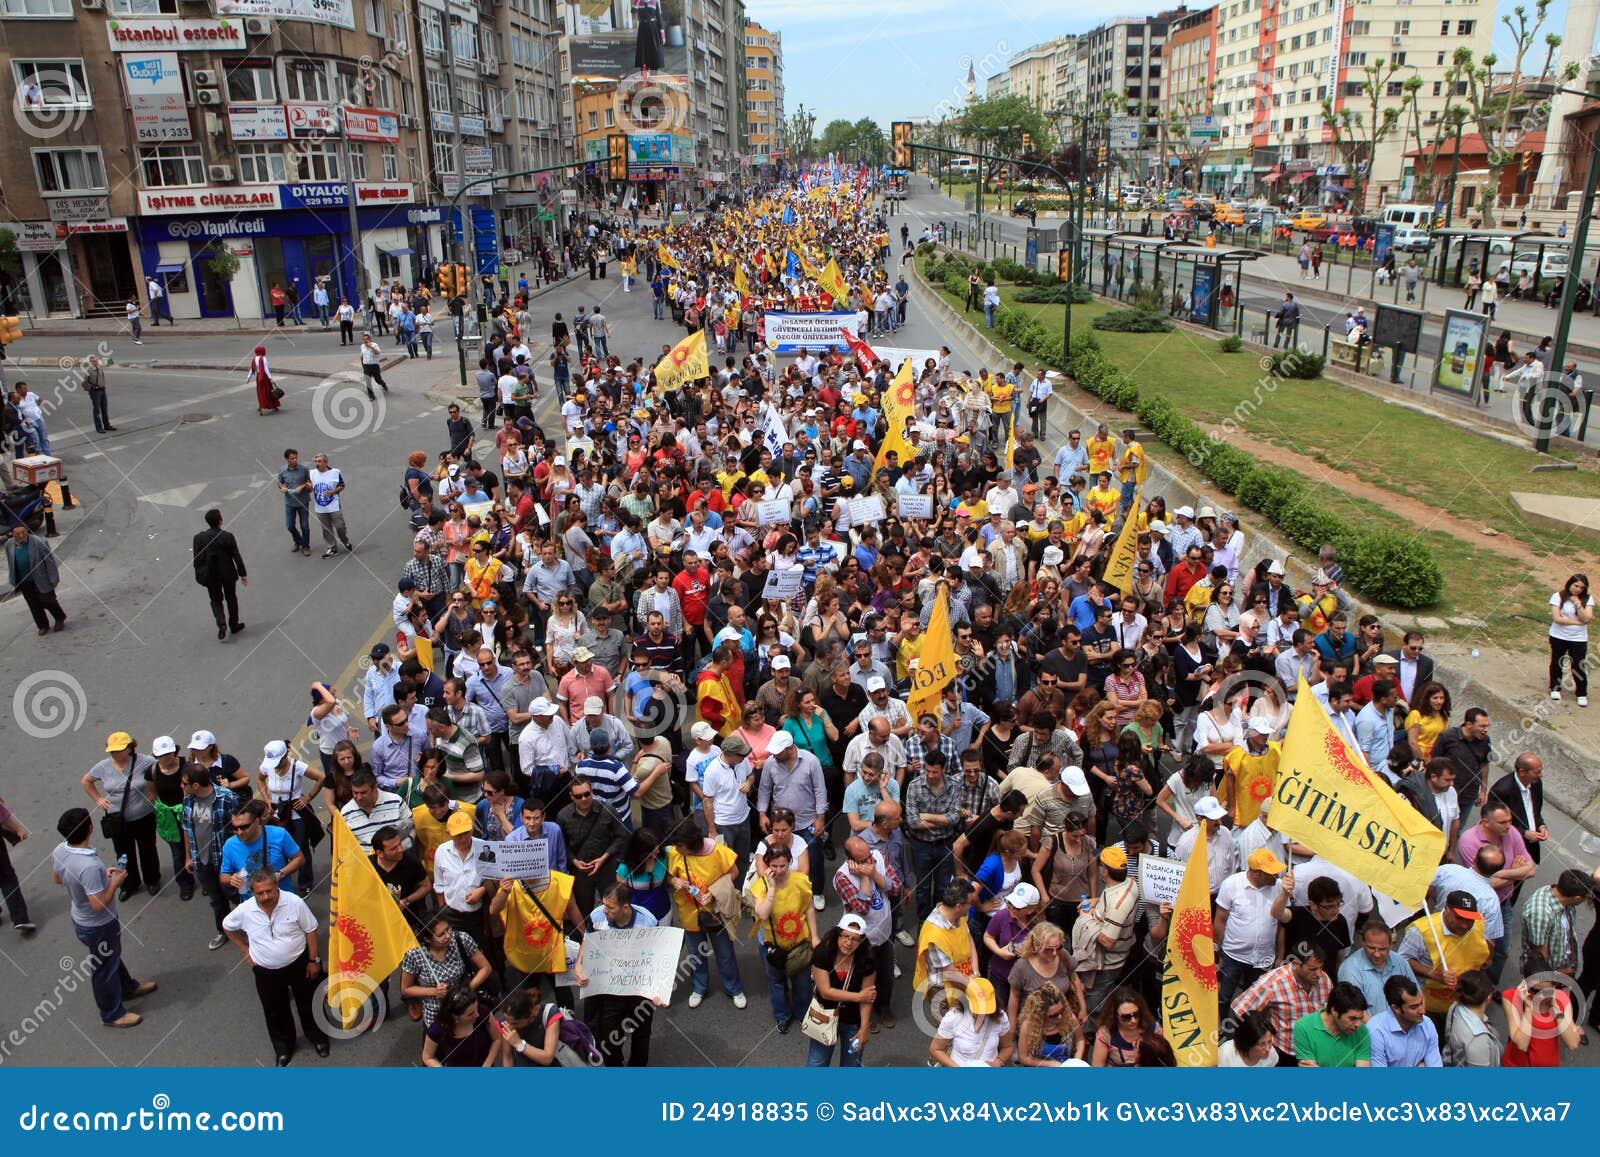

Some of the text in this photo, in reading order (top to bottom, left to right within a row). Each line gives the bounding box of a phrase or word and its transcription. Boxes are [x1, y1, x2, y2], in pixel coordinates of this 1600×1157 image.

[183, 21, 239, 40] estetik
[140, 129, 158, 138] 543
[170, 128, 189, 137] 333
[147, 192, 274, 210] İŞİTME CİHAZLARI
[306, 198, 321, 206] 529
[200, 218, 266, 236] YapıKredi
[425, 697, 435, 705] 87
[1275, 769, 1416, 869] ĞİTİM SEN
[1163, 990, 1207, 1050] SEN
